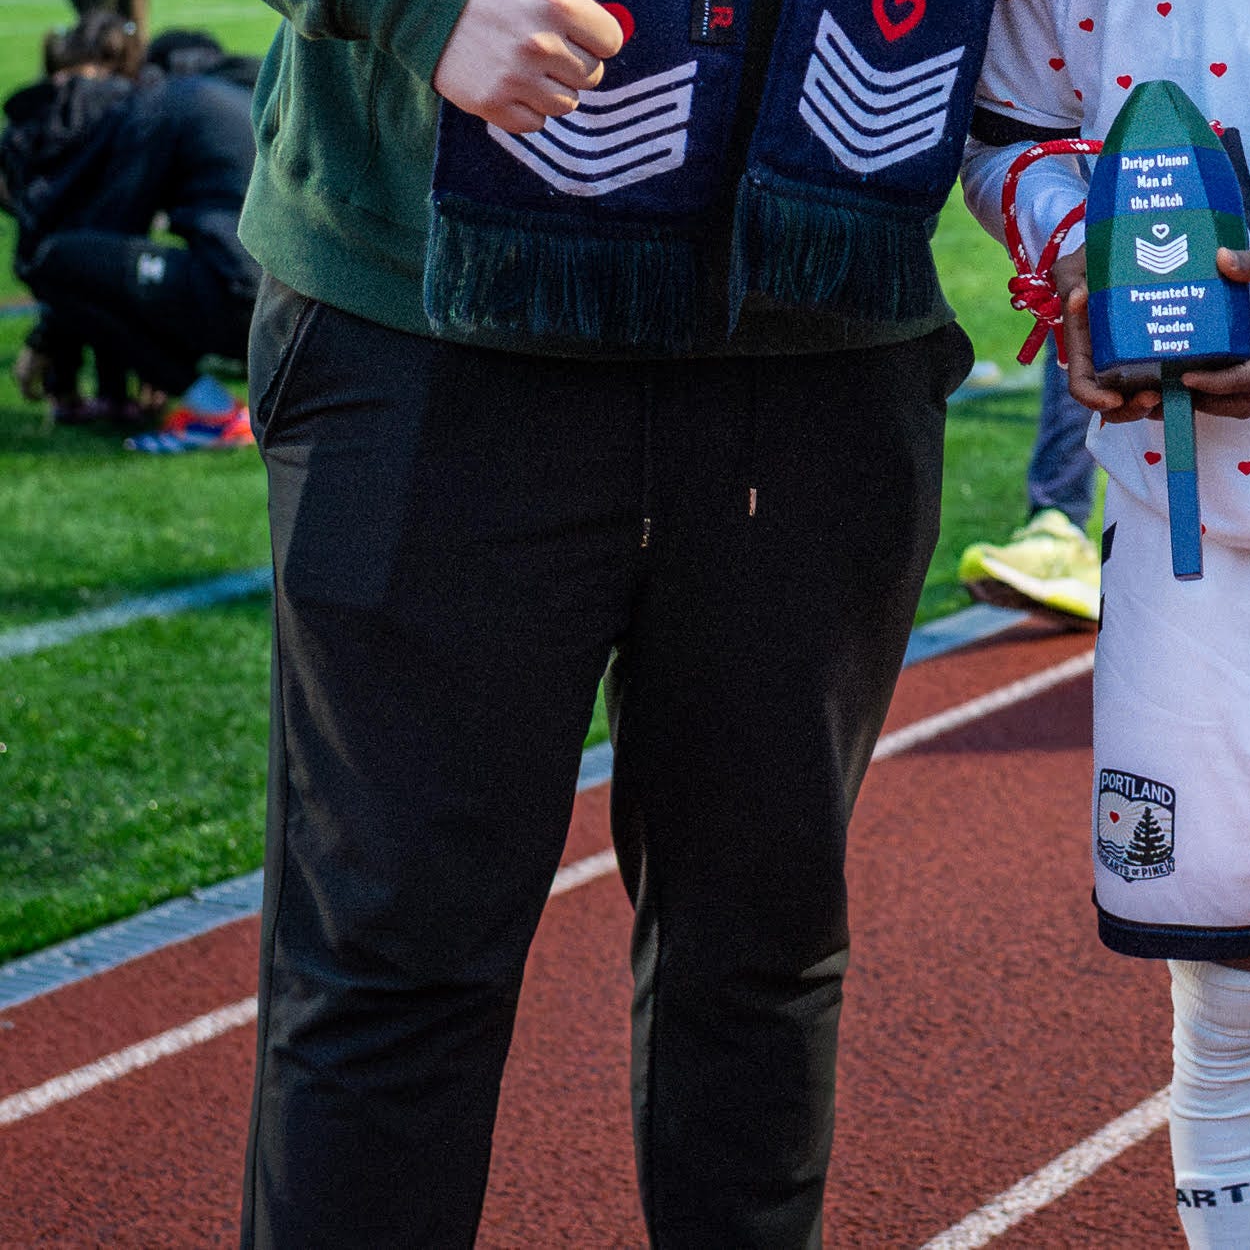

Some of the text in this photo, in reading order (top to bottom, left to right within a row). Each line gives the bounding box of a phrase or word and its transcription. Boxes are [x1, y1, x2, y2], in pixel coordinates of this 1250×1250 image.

[1121, 154, 1190, 172] Dirigo Union
[1136, 174, 1173, 189] Man of
[1131, 193, 1184, 210] the Match
[1130, 285, 1206, 302] Presented by
[1151, 304, 1187, 317] Maine
[1146, 321, 1195, 335] Wooden
[1153, 338, 1190, 352] Buoys
[1101, 771, 1173, 806] PORTLAND
[1141, 863, 1167, 878] PINE
